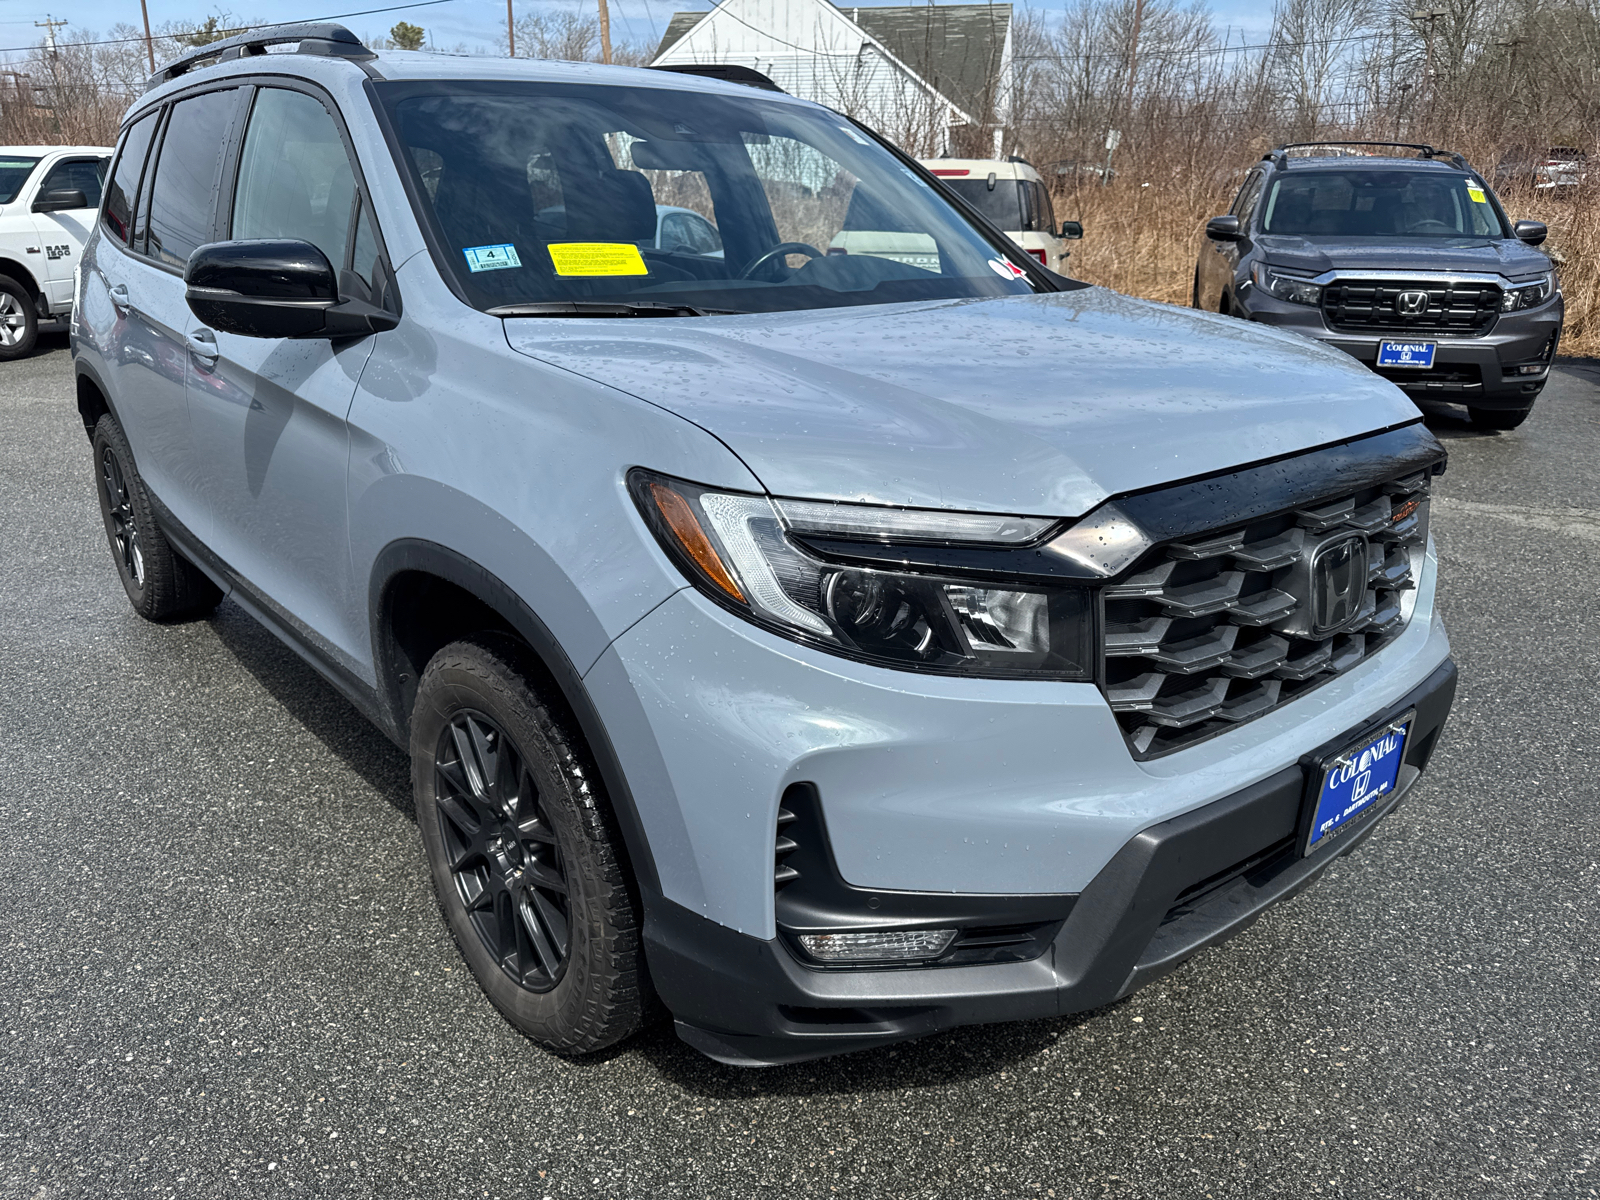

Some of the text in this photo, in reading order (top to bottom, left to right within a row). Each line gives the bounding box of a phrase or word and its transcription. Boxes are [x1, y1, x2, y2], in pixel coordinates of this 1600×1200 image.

[487, 251, 495, 259] 4
[1387, 344, 1428, 352] COLONIAL
[1329, 736, 1397, 789] COLONIAL
[1320, 818, 1334, 832] RTE.
[1335, 814, 1340, 822] 6
[1379, 780, 1388, 792] MA
